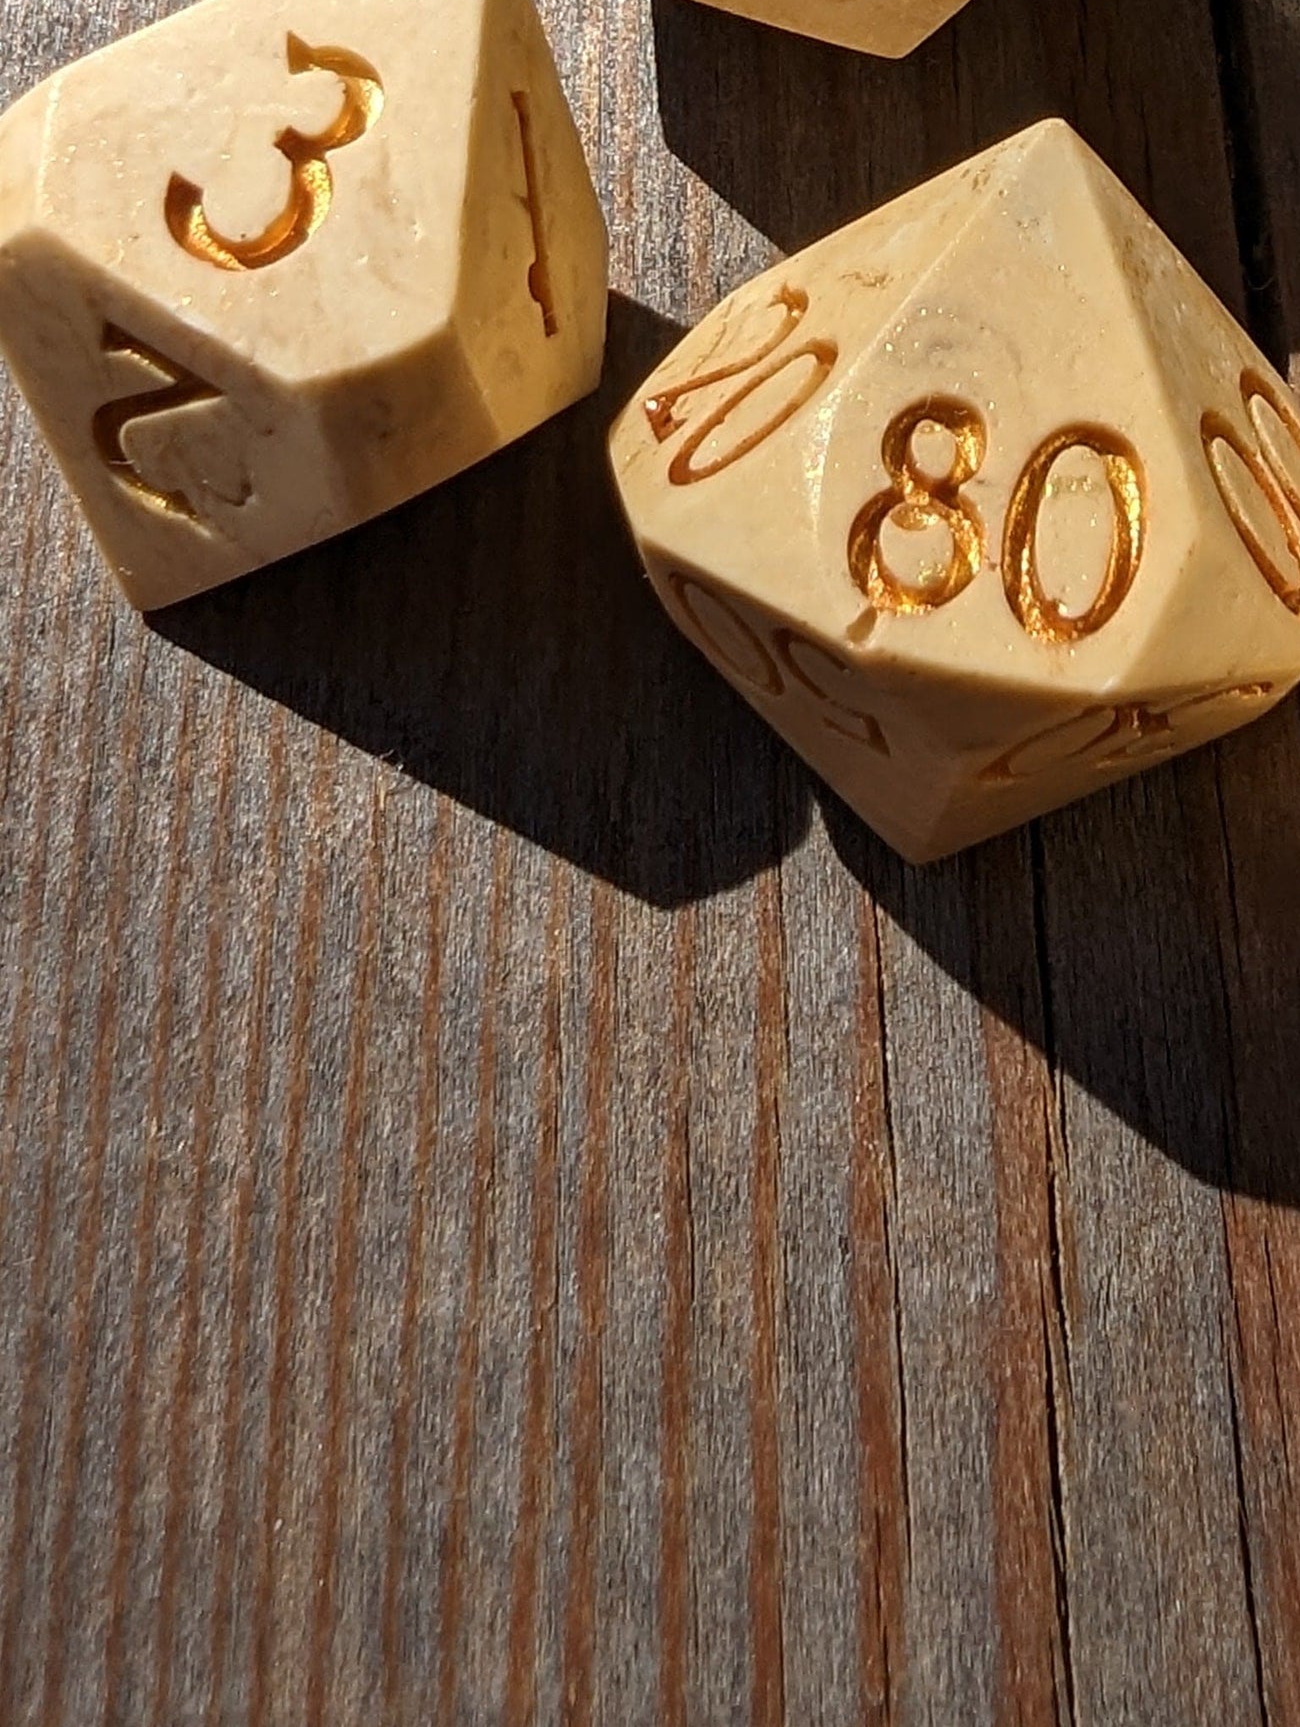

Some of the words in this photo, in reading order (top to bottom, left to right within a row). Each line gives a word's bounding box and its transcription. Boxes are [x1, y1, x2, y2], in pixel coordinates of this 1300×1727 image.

[163, 29, 384, 272] 3
[643, 282, 839, 487] 20
[846, 392, 1149, 646] 80
